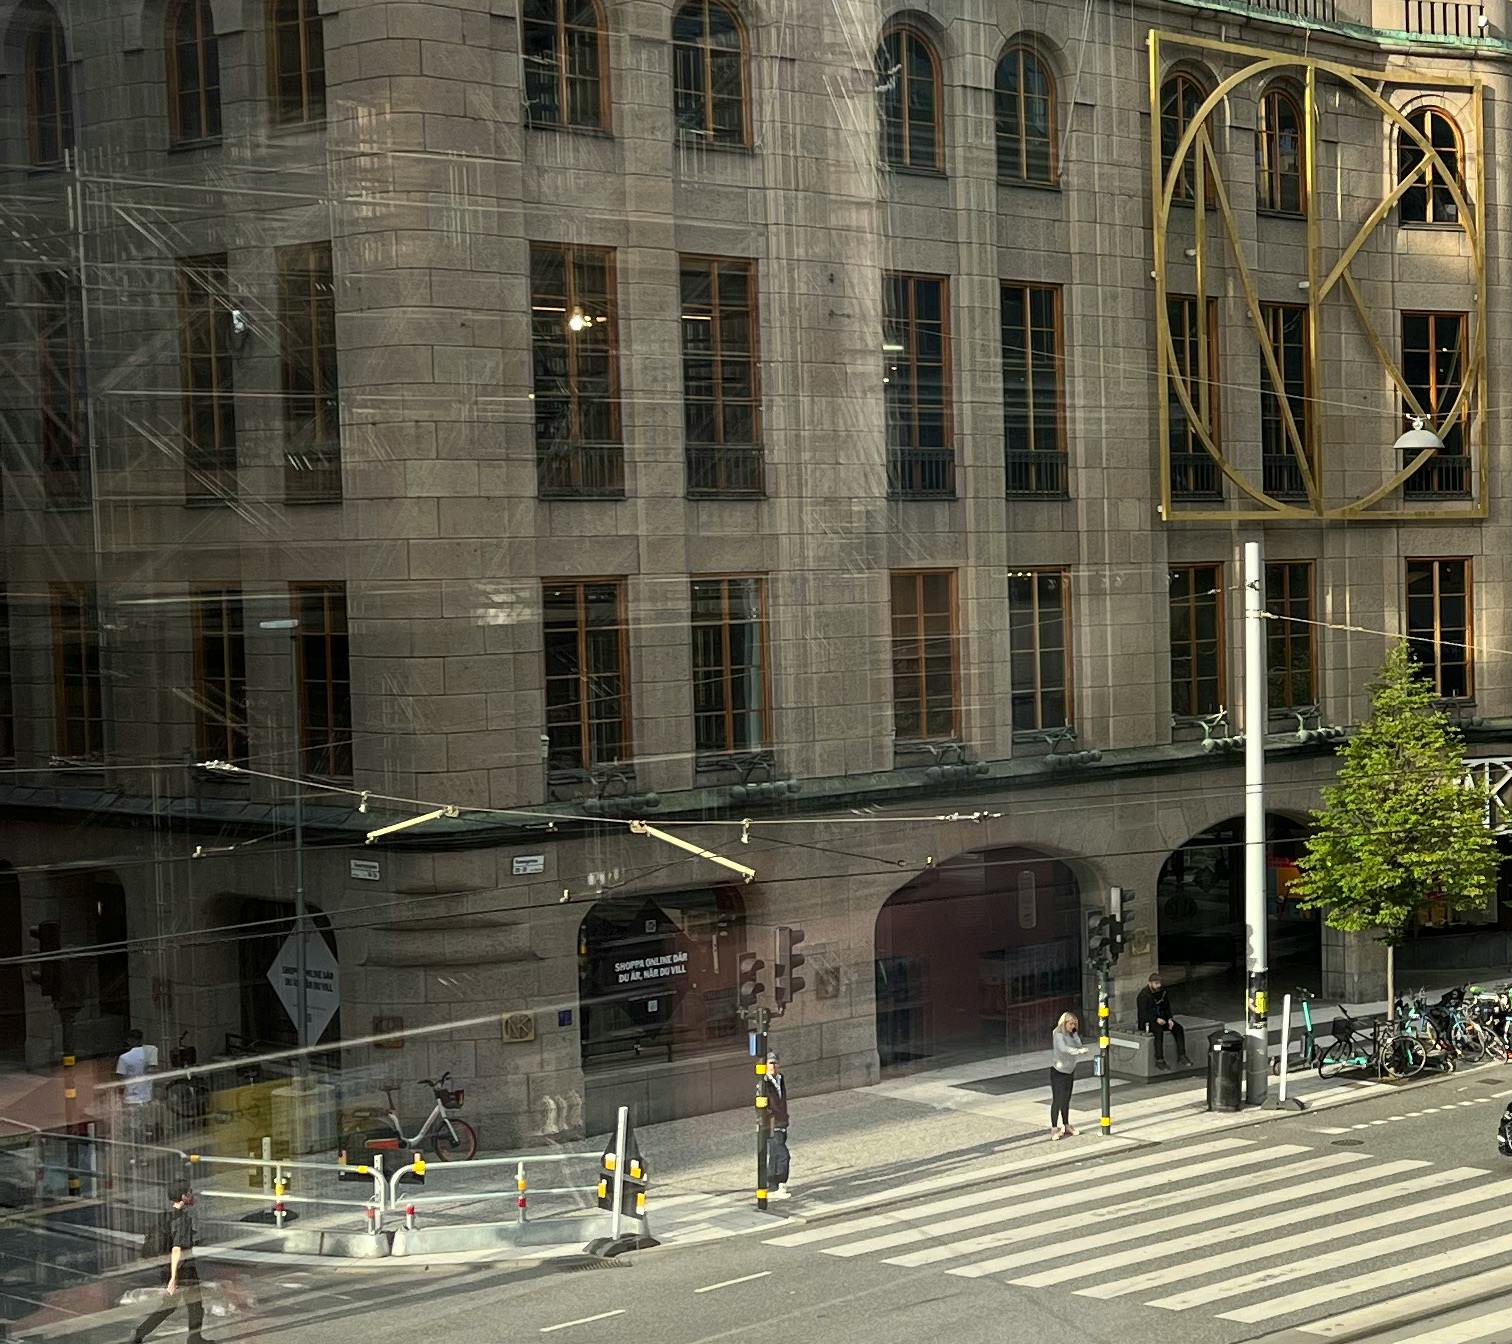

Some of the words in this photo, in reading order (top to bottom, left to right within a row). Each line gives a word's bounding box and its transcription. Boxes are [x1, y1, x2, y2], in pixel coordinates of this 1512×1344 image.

[1162, 56, 1484, 520] NK
[614, 960, 644, 972] SHOPPA
[645, 956, 672, 967] ONLINE
[672, 952, 688, 963] DÄR
[618, 973, 630, 983] DU
[659, 967, 670, 976] DU
[671, 965, 687, 974] VILL
